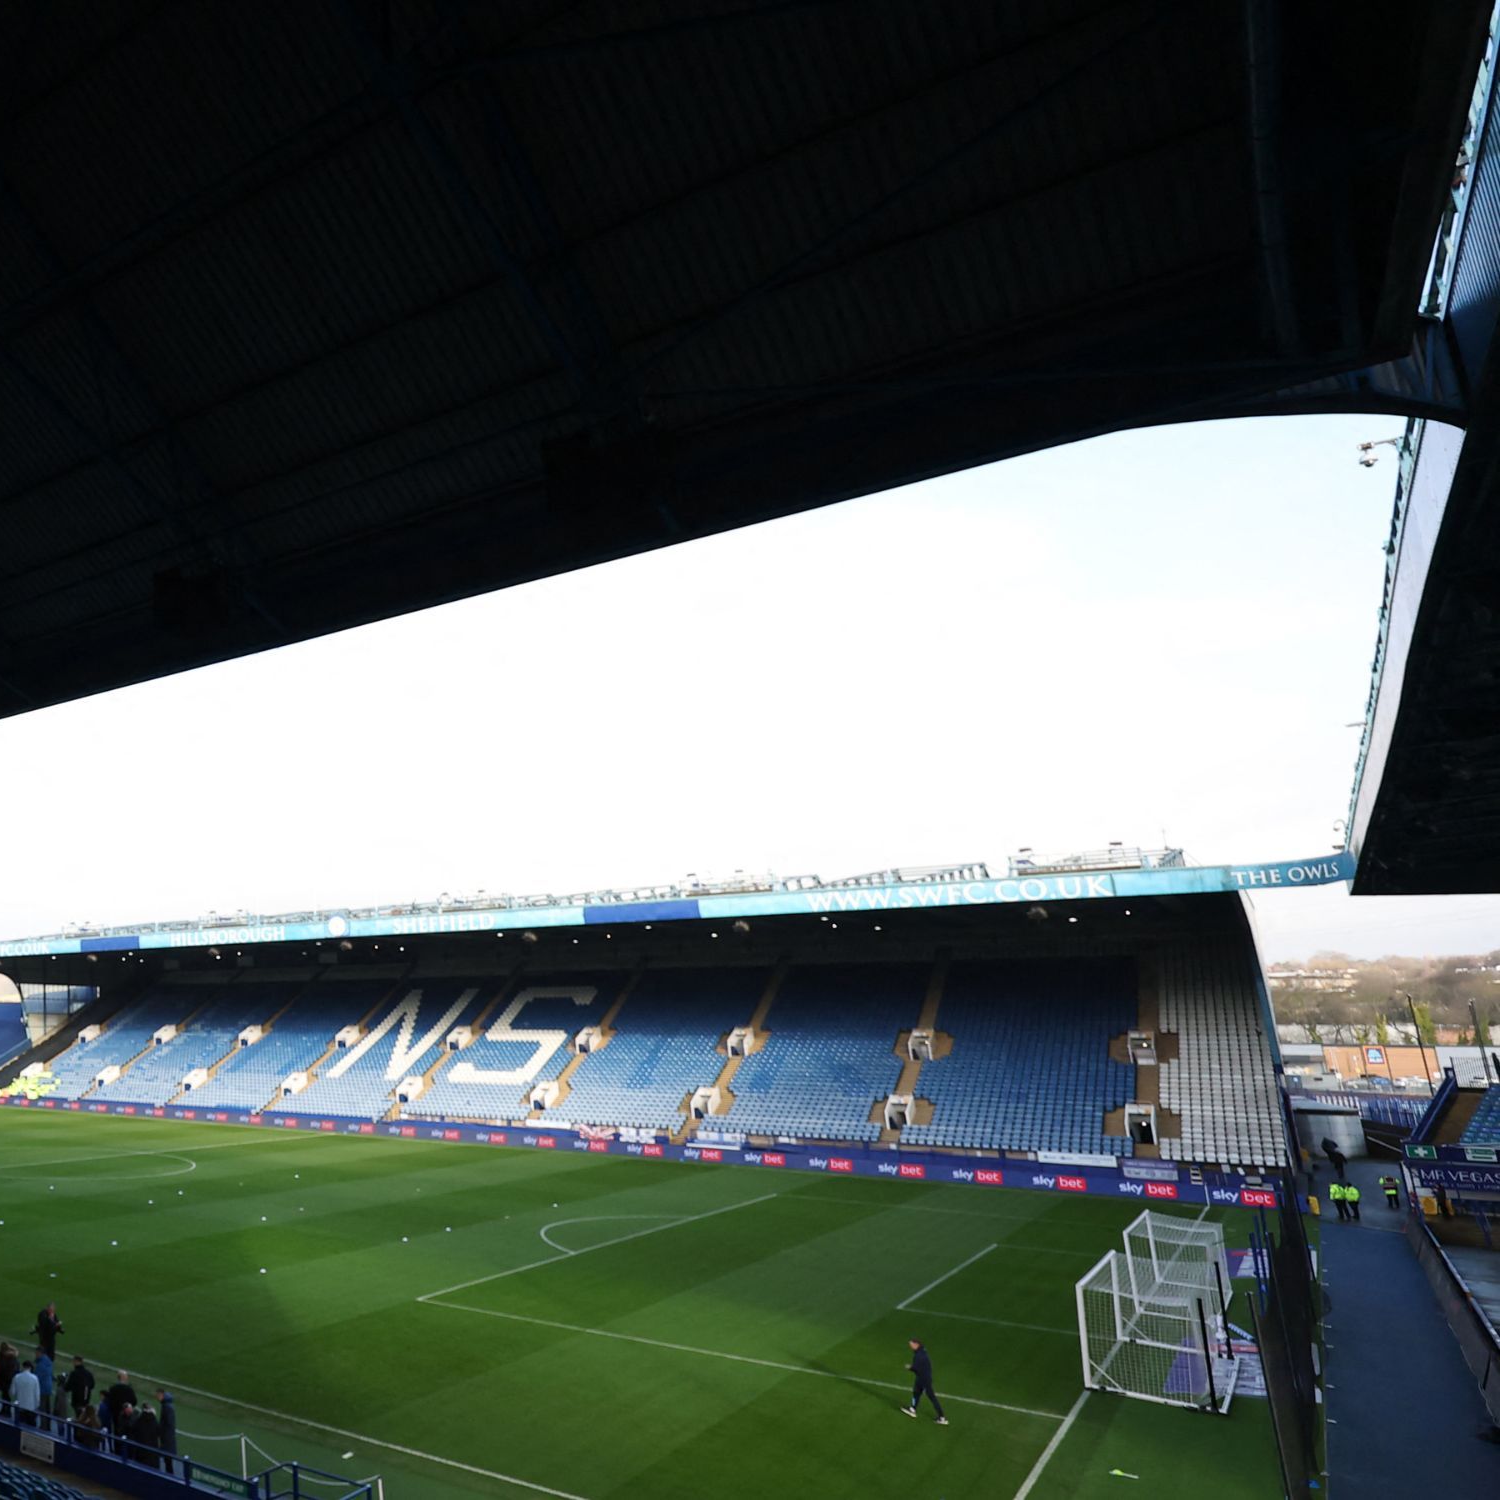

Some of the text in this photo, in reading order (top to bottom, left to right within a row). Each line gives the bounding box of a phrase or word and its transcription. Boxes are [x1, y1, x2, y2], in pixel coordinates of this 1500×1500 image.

[1230, 861, 1340, 886] THE OWLS
[804, 875, 1115, 912] WWW.SWFC.CO.UK
[393, 913, 495, 934] SHEFFIELD
[169, 926, 286, 947] HILLSBOROUGH
[523, 1136, 554, 1147] sky bet
[573, 1139, 606, 1151] sky bet
[627, 1144, 661, 1156] sky bet
[684, 1148, 720, 1160] sky bet
[744, 1152, 782, 1165] sky bet
[809, 1157, 850, 1170] sky bet
[878, 1162, 922, 1177] sky bet
[952, 1168, 1000, 1183] sky bet
[1419, 1168, 1500, 1184] MR VEGAS
[1032, 1174, 1084, 1190] sky bet
[1119, 1181, 1176, 1197] sky bet
[1212, 1188, 1273, 1205] sky bet
